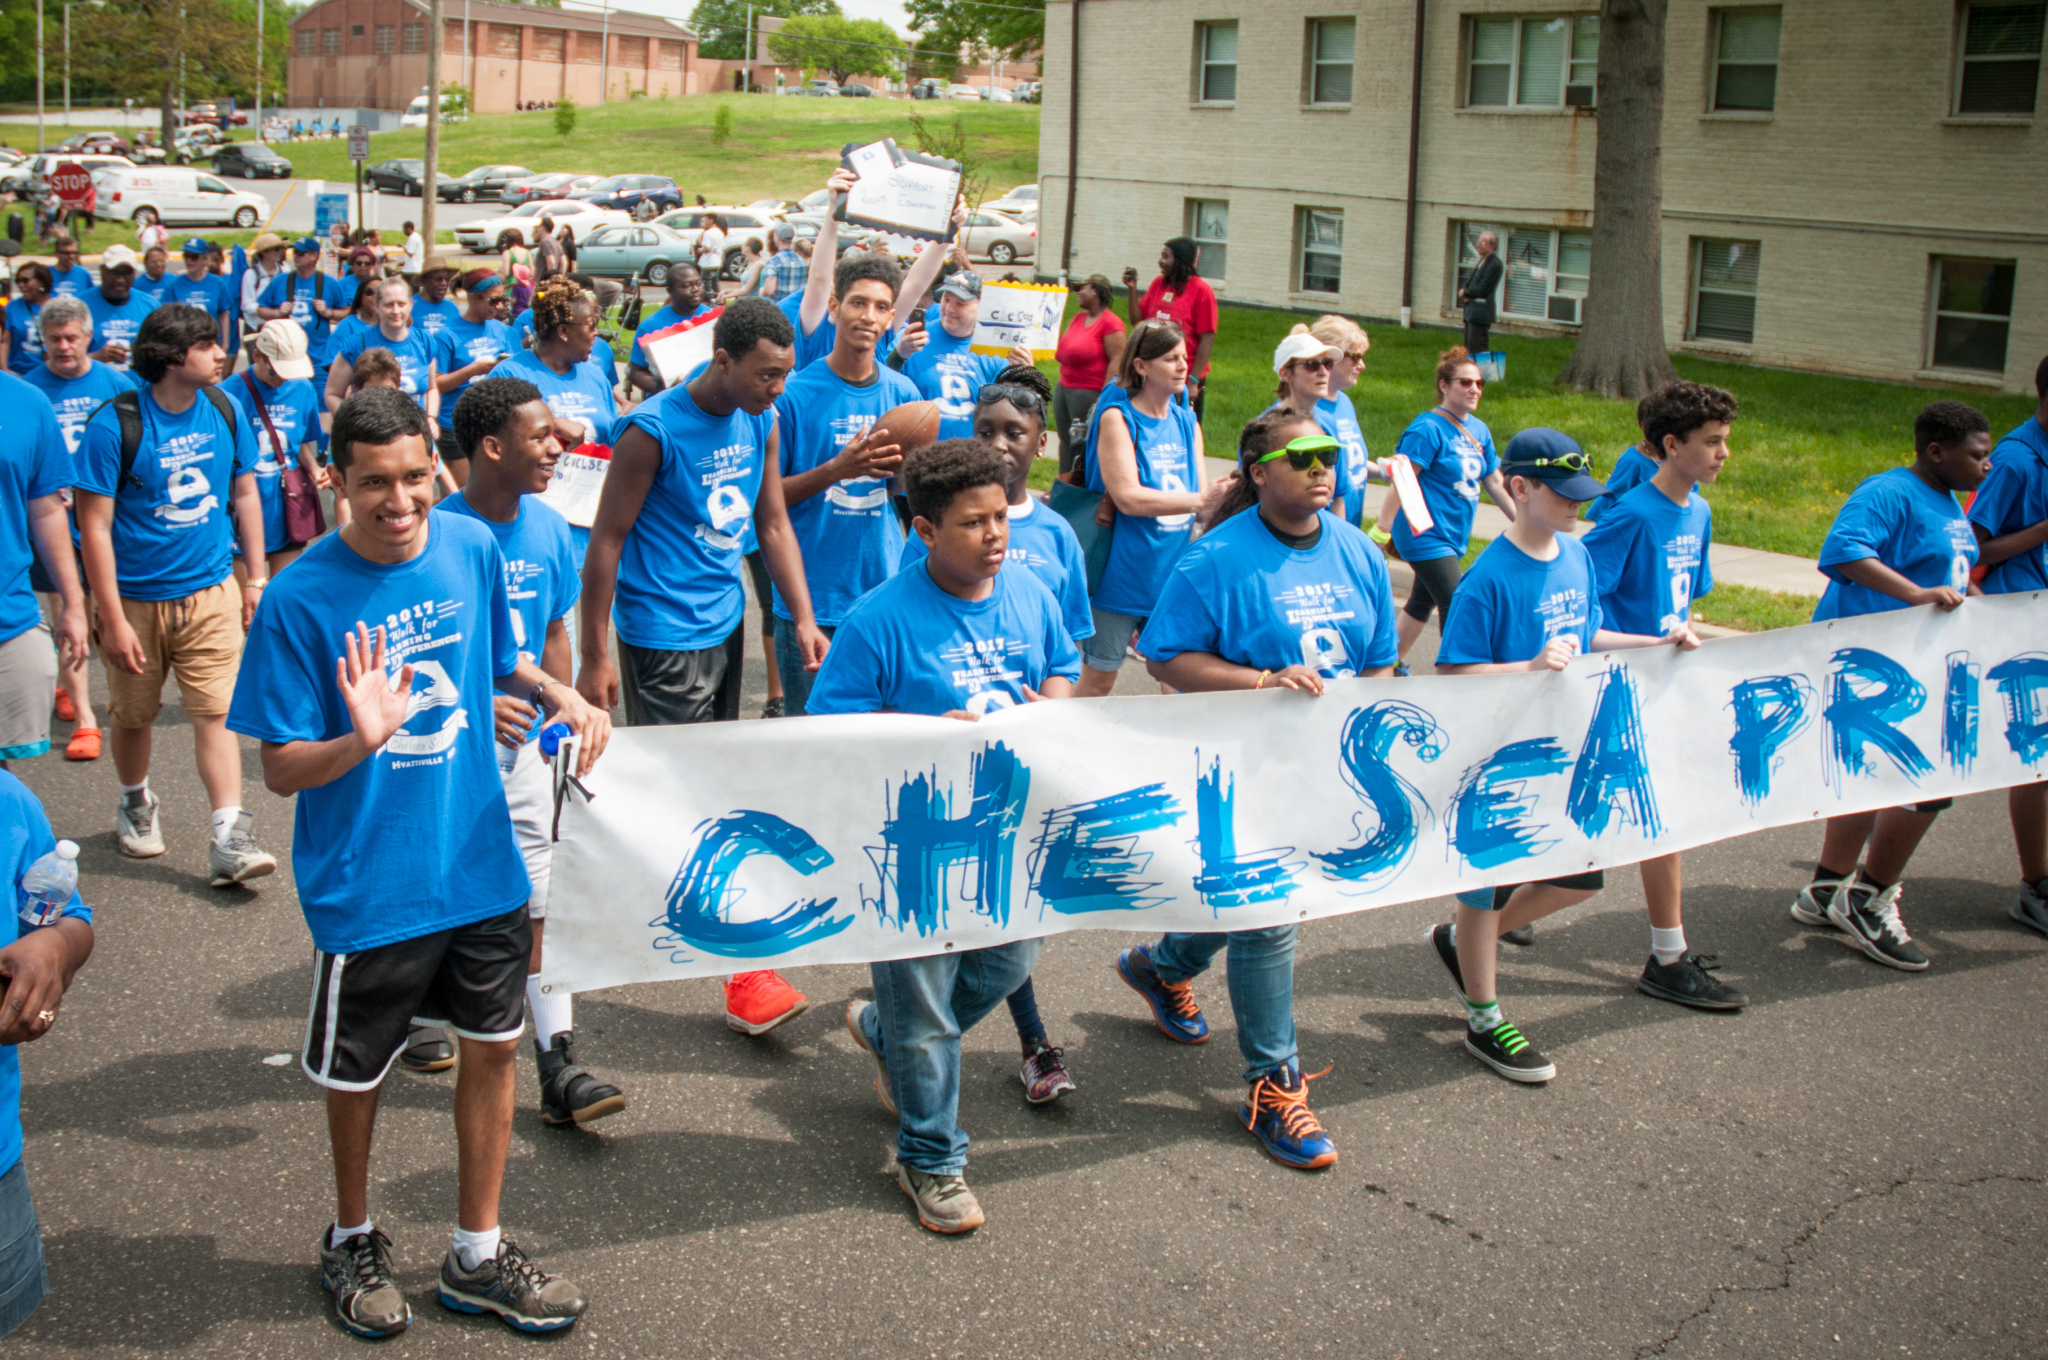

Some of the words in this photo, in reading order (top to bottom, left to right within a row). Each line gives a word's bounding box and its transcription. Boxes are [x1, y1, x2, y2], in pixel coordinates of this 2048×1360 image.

[52, 173, 89, 191] STOP
[888, 172, 934, 194] SUPPORT
[897, 193, 936, 210] EDUCATION
[1156, 309, 1170, 320] free
[848, 415, 877, 424] 2017
[169, 432, 200, 447] 2017
[713, 444, 740, 460] 2017
[1677, 535, 1696, 546] 2017
[1295, 583, 1331, 597] 2017
[1551, 589, 1576, 605] 2017
[1300, 596, 1321, 607] Walk
[1324, 595, 1336, 606] for
[386, 600, 435, 630] 2017
[1286, 606, 1333, 624] LEARNING
[389, 621, 416, 642] Walk
[422, 617, 438, 634] for
[390, 632, 462, 671] DIFFERENCES
[964, 637, 1005, 654] 2017
[966, 652, 992, 666] Walk
[993, 652, 1006, 666] for
[952, 665, 1003, 686] LEARNING
[391, 737, 426, 751] Chelsea
[649, 662, 1668, 962] CHELSEA
